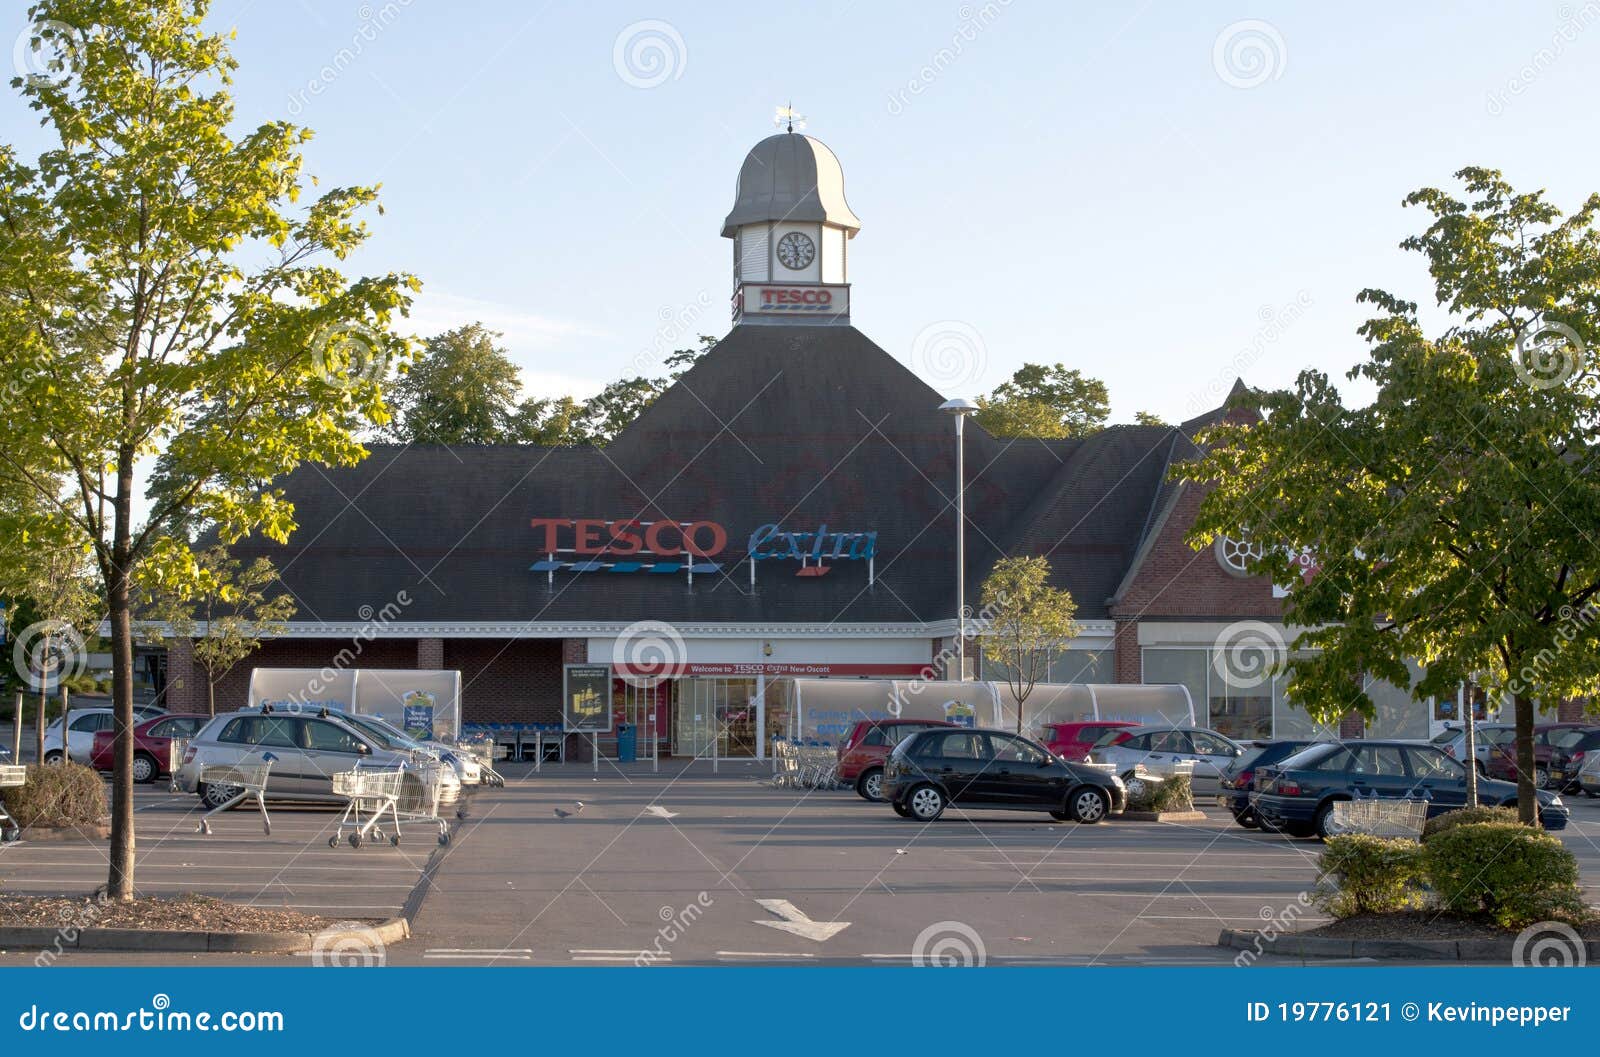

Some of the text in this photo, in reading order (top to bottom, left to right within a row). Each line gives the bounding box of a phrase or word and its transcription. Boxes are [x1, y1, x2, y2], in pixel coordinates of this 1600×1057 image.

[761, 289, 832, 304] TESCO
[530, 518, 879, 560] TESCO extra
[691, 665, 722, 673] Welcome
[724, 665, 732, 673] to
[766, 664, 788, 672] extra
[806, 665, 830, 673] Oscott
